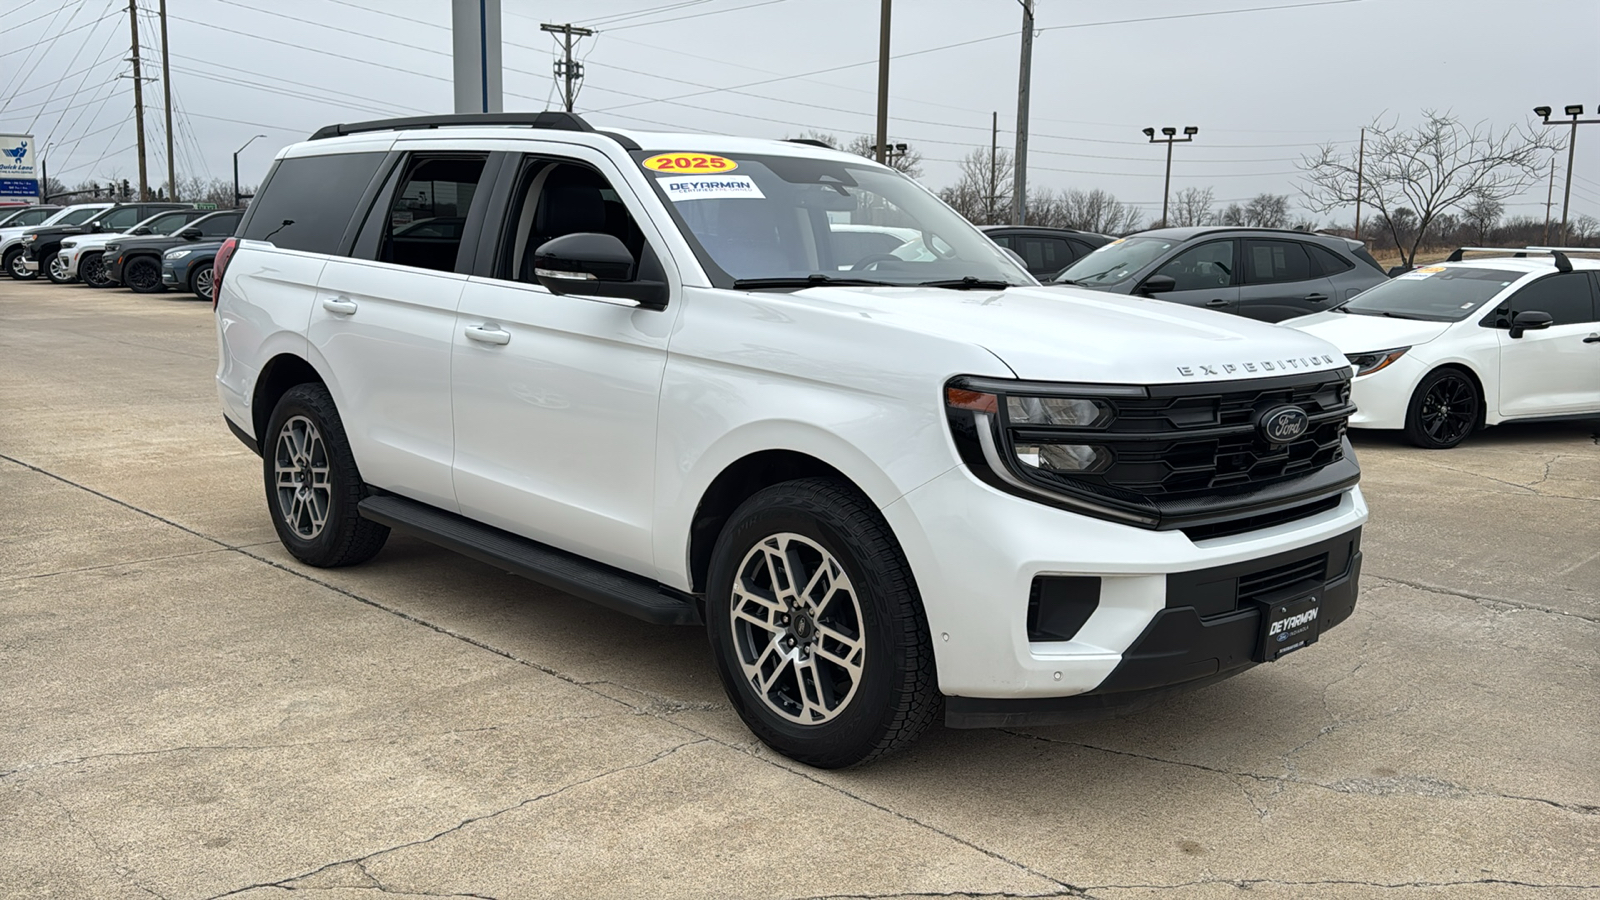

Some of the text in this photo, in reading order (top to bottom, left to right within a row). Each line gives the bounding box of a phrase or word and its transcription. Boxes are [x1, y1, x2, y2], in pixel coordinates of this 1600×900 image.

[656, 157, 727, 169] 2025
[669, 181, 751, 191] DEYARMAN
[1177, 354, 1334, 377] EXPEDITION
[1275, 414, 1302, 436] Ford
[1269, 606, 1319, 636] DEYARMAN
